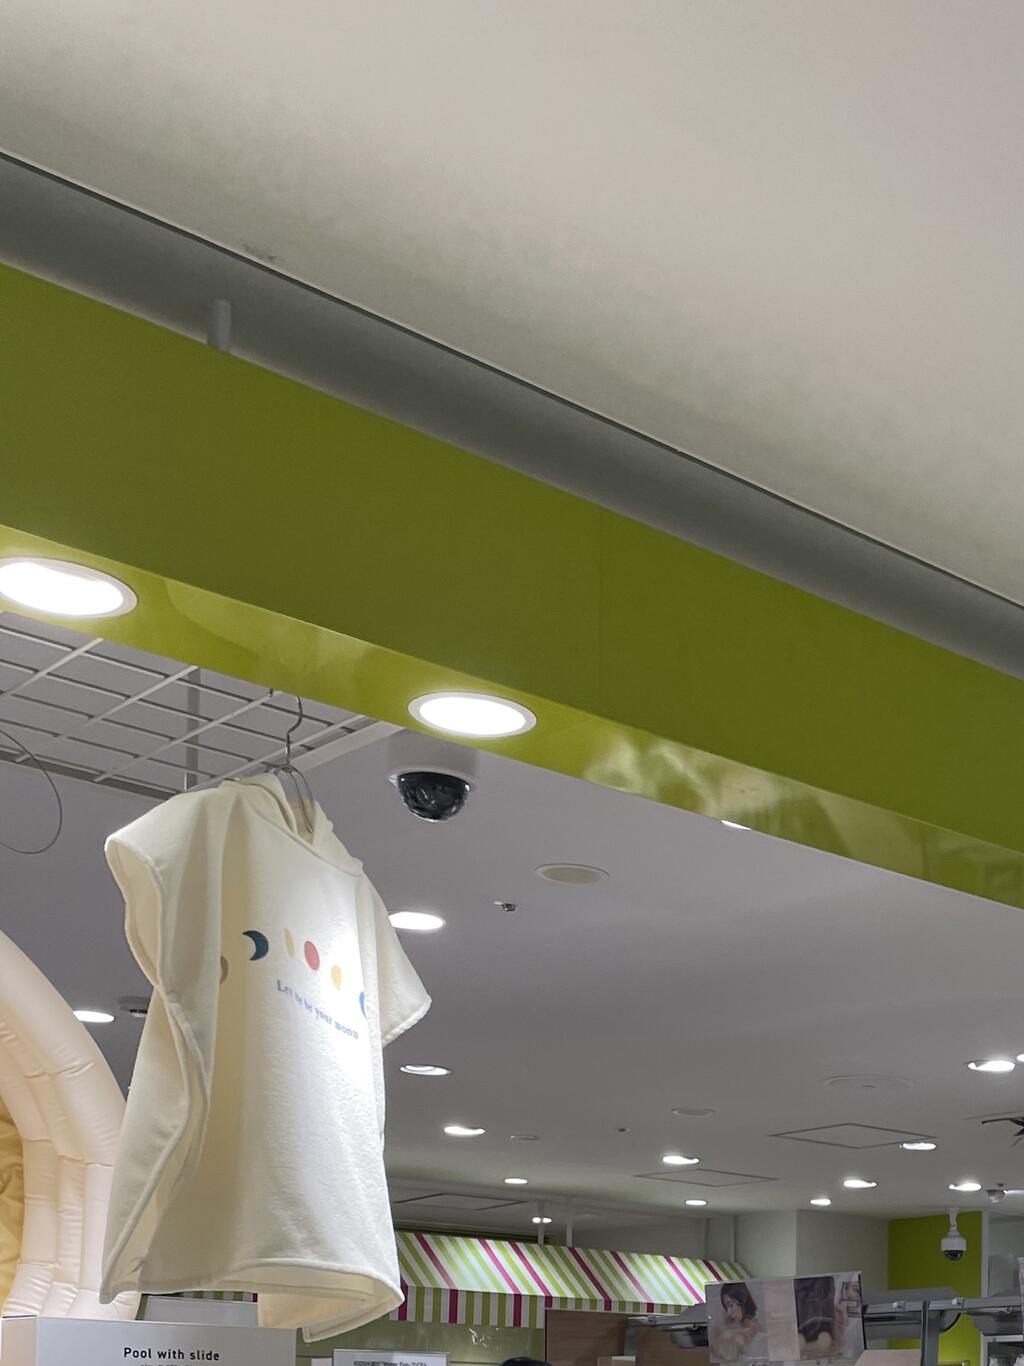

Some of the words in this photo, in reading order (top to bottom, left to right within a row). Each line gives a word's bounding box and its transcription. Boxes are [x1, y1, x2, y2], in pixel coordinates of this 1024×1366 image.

[123, 1347, 152, 1359] Pool
[157, 1348, 185, 1360] with
[189, 1350, 220, 1361] slide
